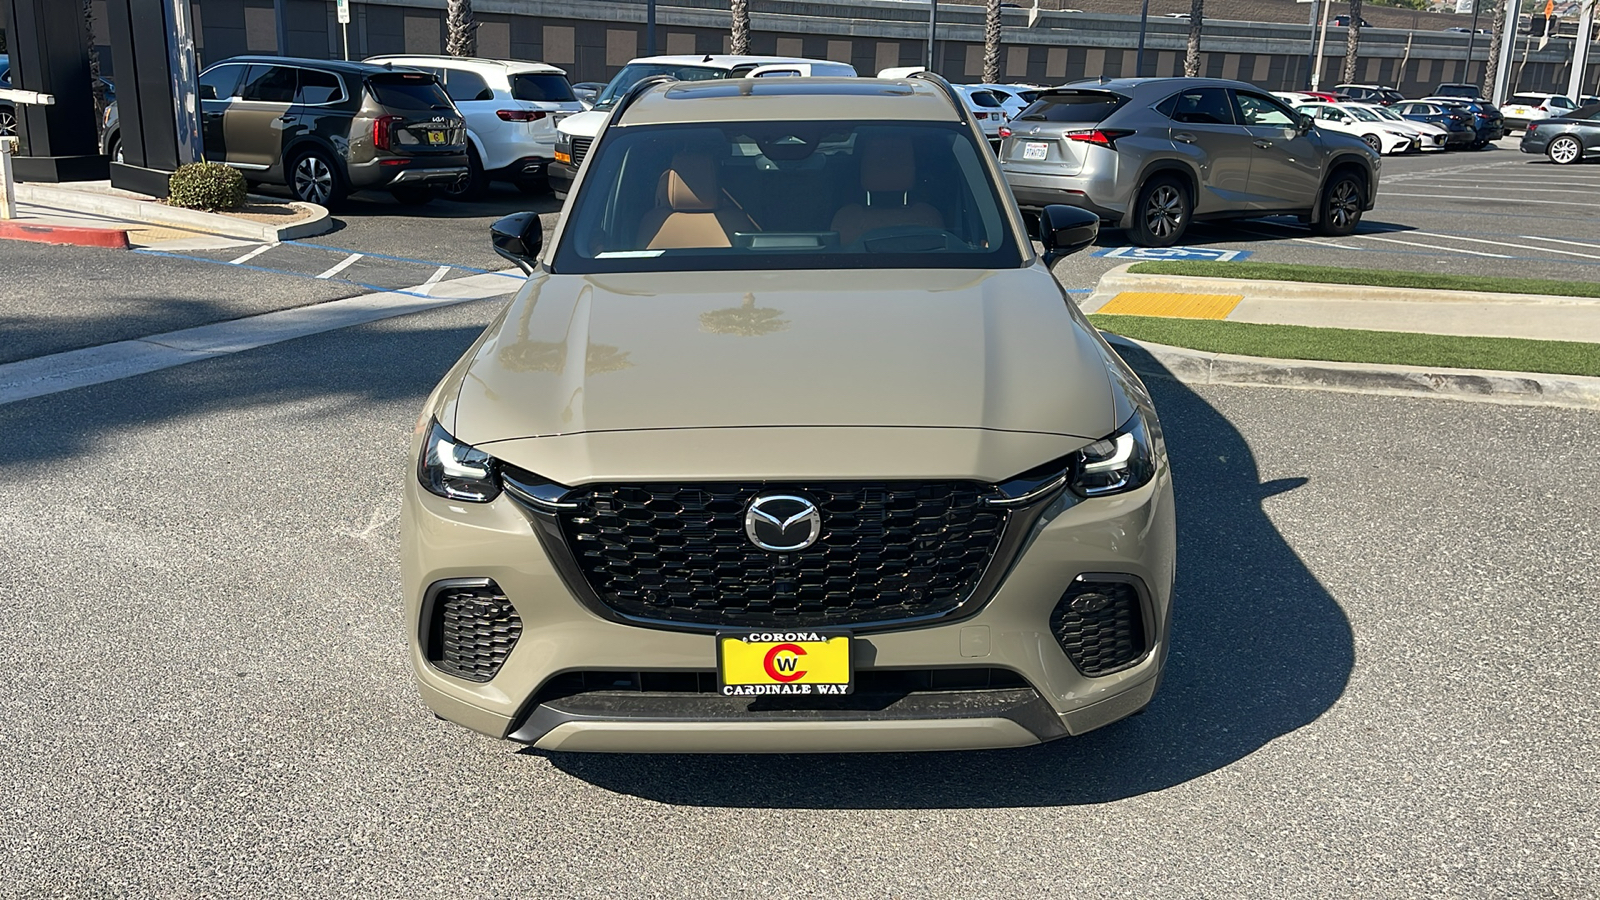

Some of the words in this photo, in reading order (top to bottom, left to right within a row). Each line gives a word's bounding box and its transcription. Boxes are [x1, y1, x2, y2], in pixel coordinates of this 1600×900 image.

[750, 632, 820, 641] CORONA
[764, 643, 807, 682] C
[777, 658, 798, 671] W
[723, 685, 811, 695] CARDINALE
[817, 685, 849, 694] WAY
